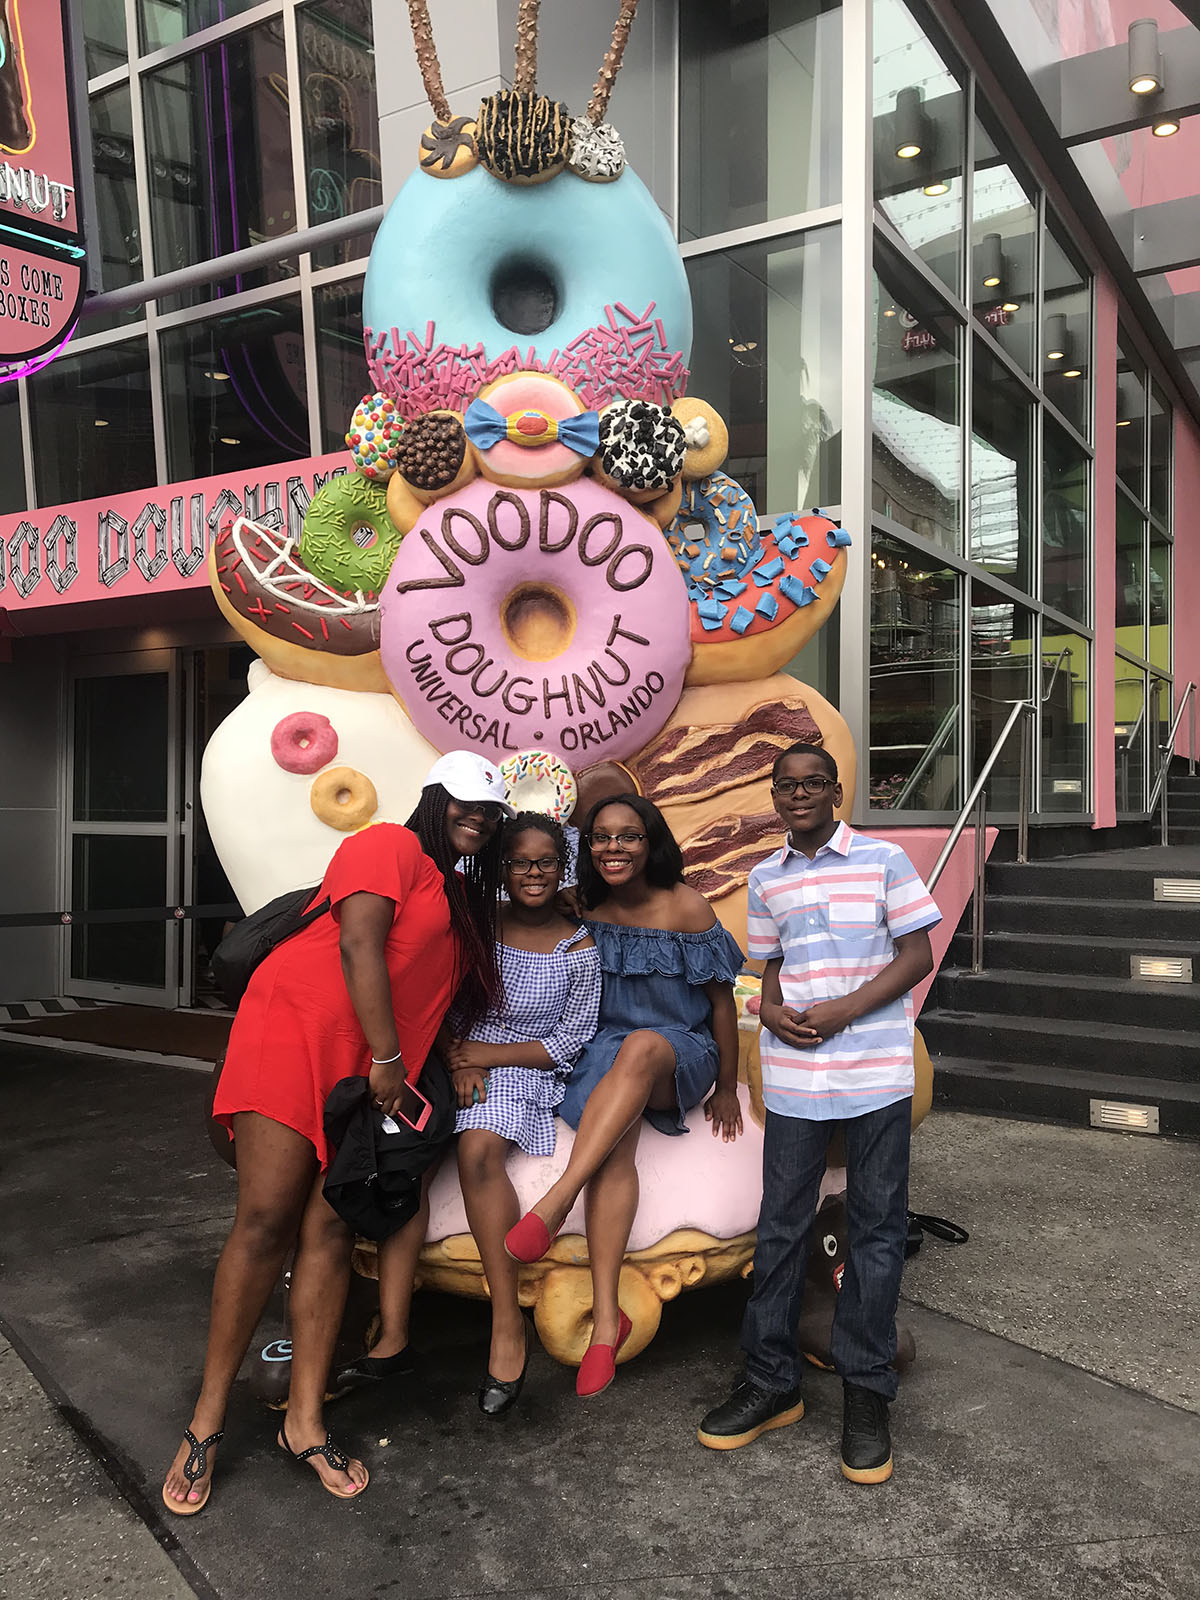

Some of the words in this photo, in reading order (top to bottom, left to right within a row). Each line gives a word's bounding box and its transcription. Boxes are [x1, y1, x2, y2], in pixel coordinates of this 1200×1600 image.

[20, 263, 64, 301] COME
[0, 515, 79, 598] OO
[397, 489, 653, 594] VOODOO
[405, 639, 519, 750] UNIVERSAL
[559, 671, 665, 751] ORLANDO
[428, 612, 650, 719] DOUGHNUT
